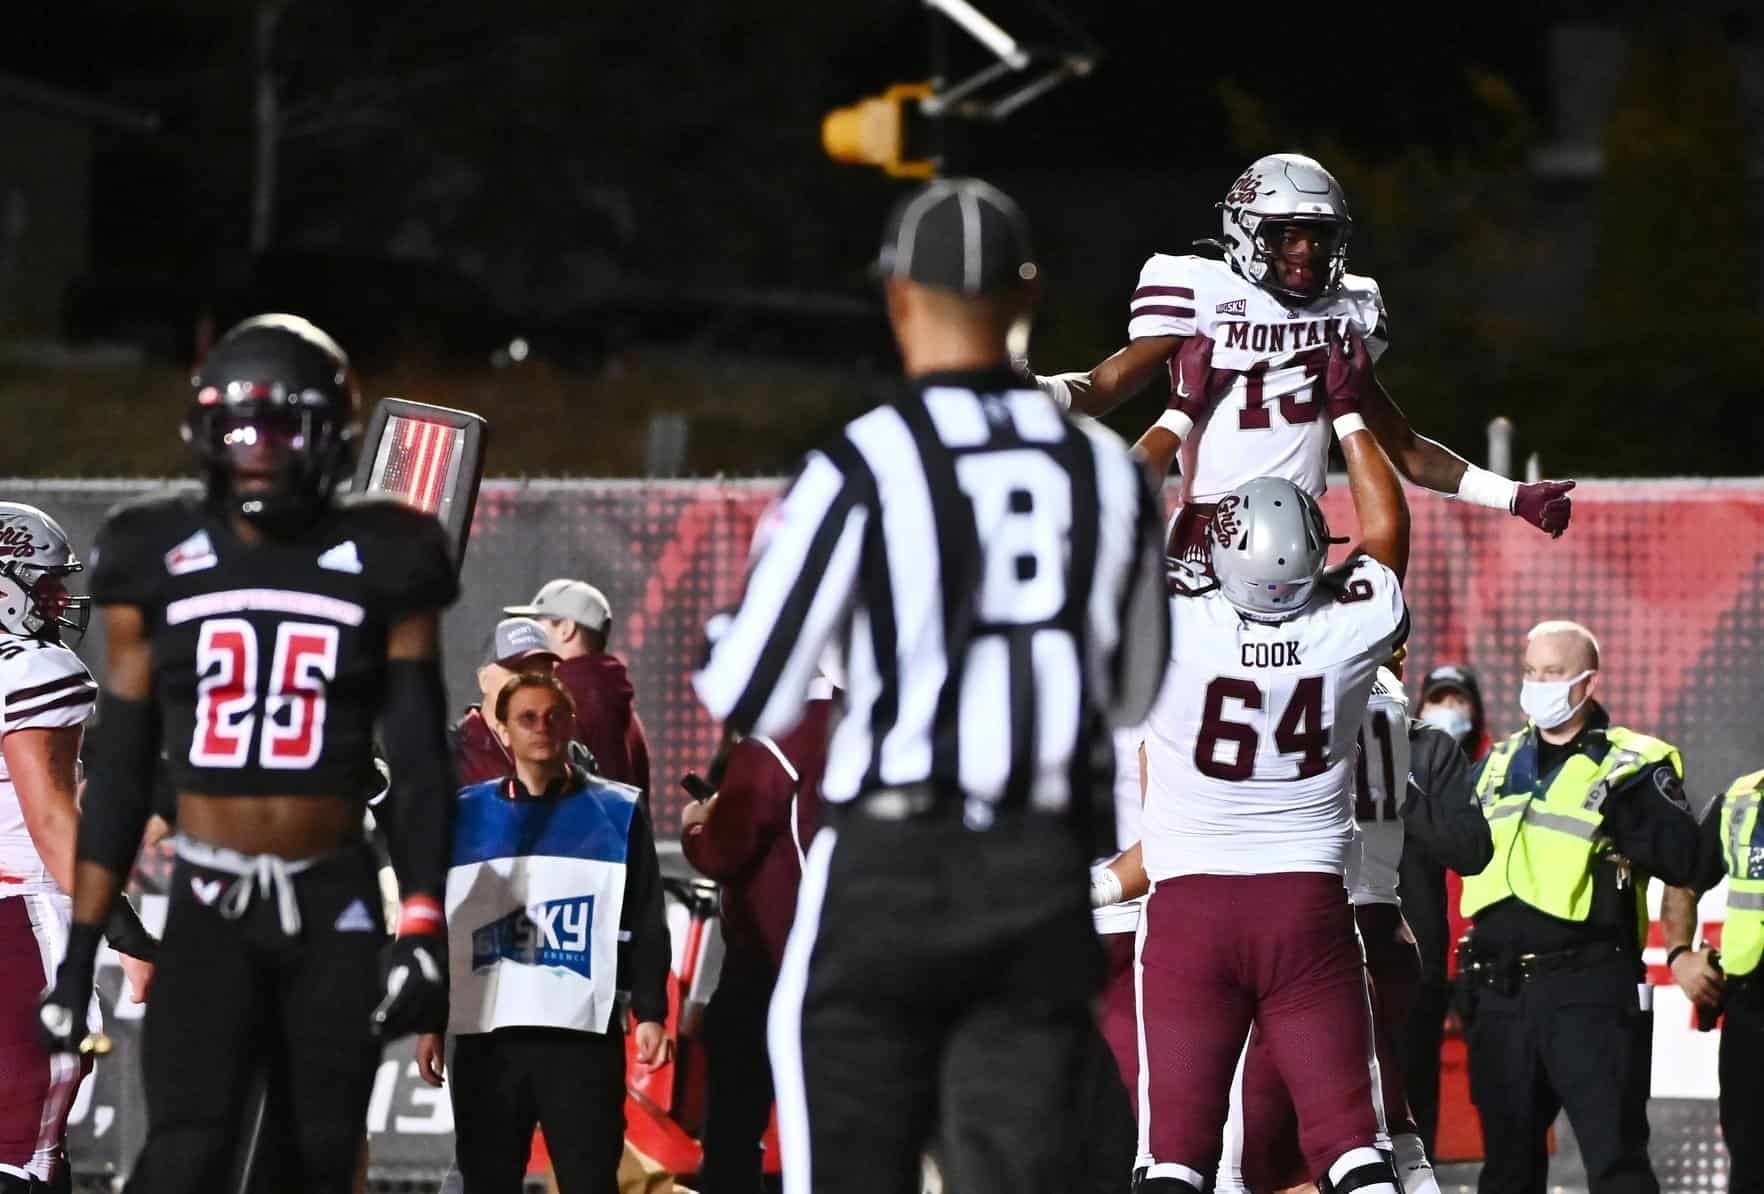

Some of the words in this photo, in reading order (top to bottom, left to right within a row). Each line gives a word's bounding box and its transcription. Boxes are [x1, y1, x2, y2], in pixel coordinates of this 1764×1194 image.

[189, 617, 340, 770] 25
[1241, 640, 1302, 668] COOK
[1194, 676, 1331, 782] 64
